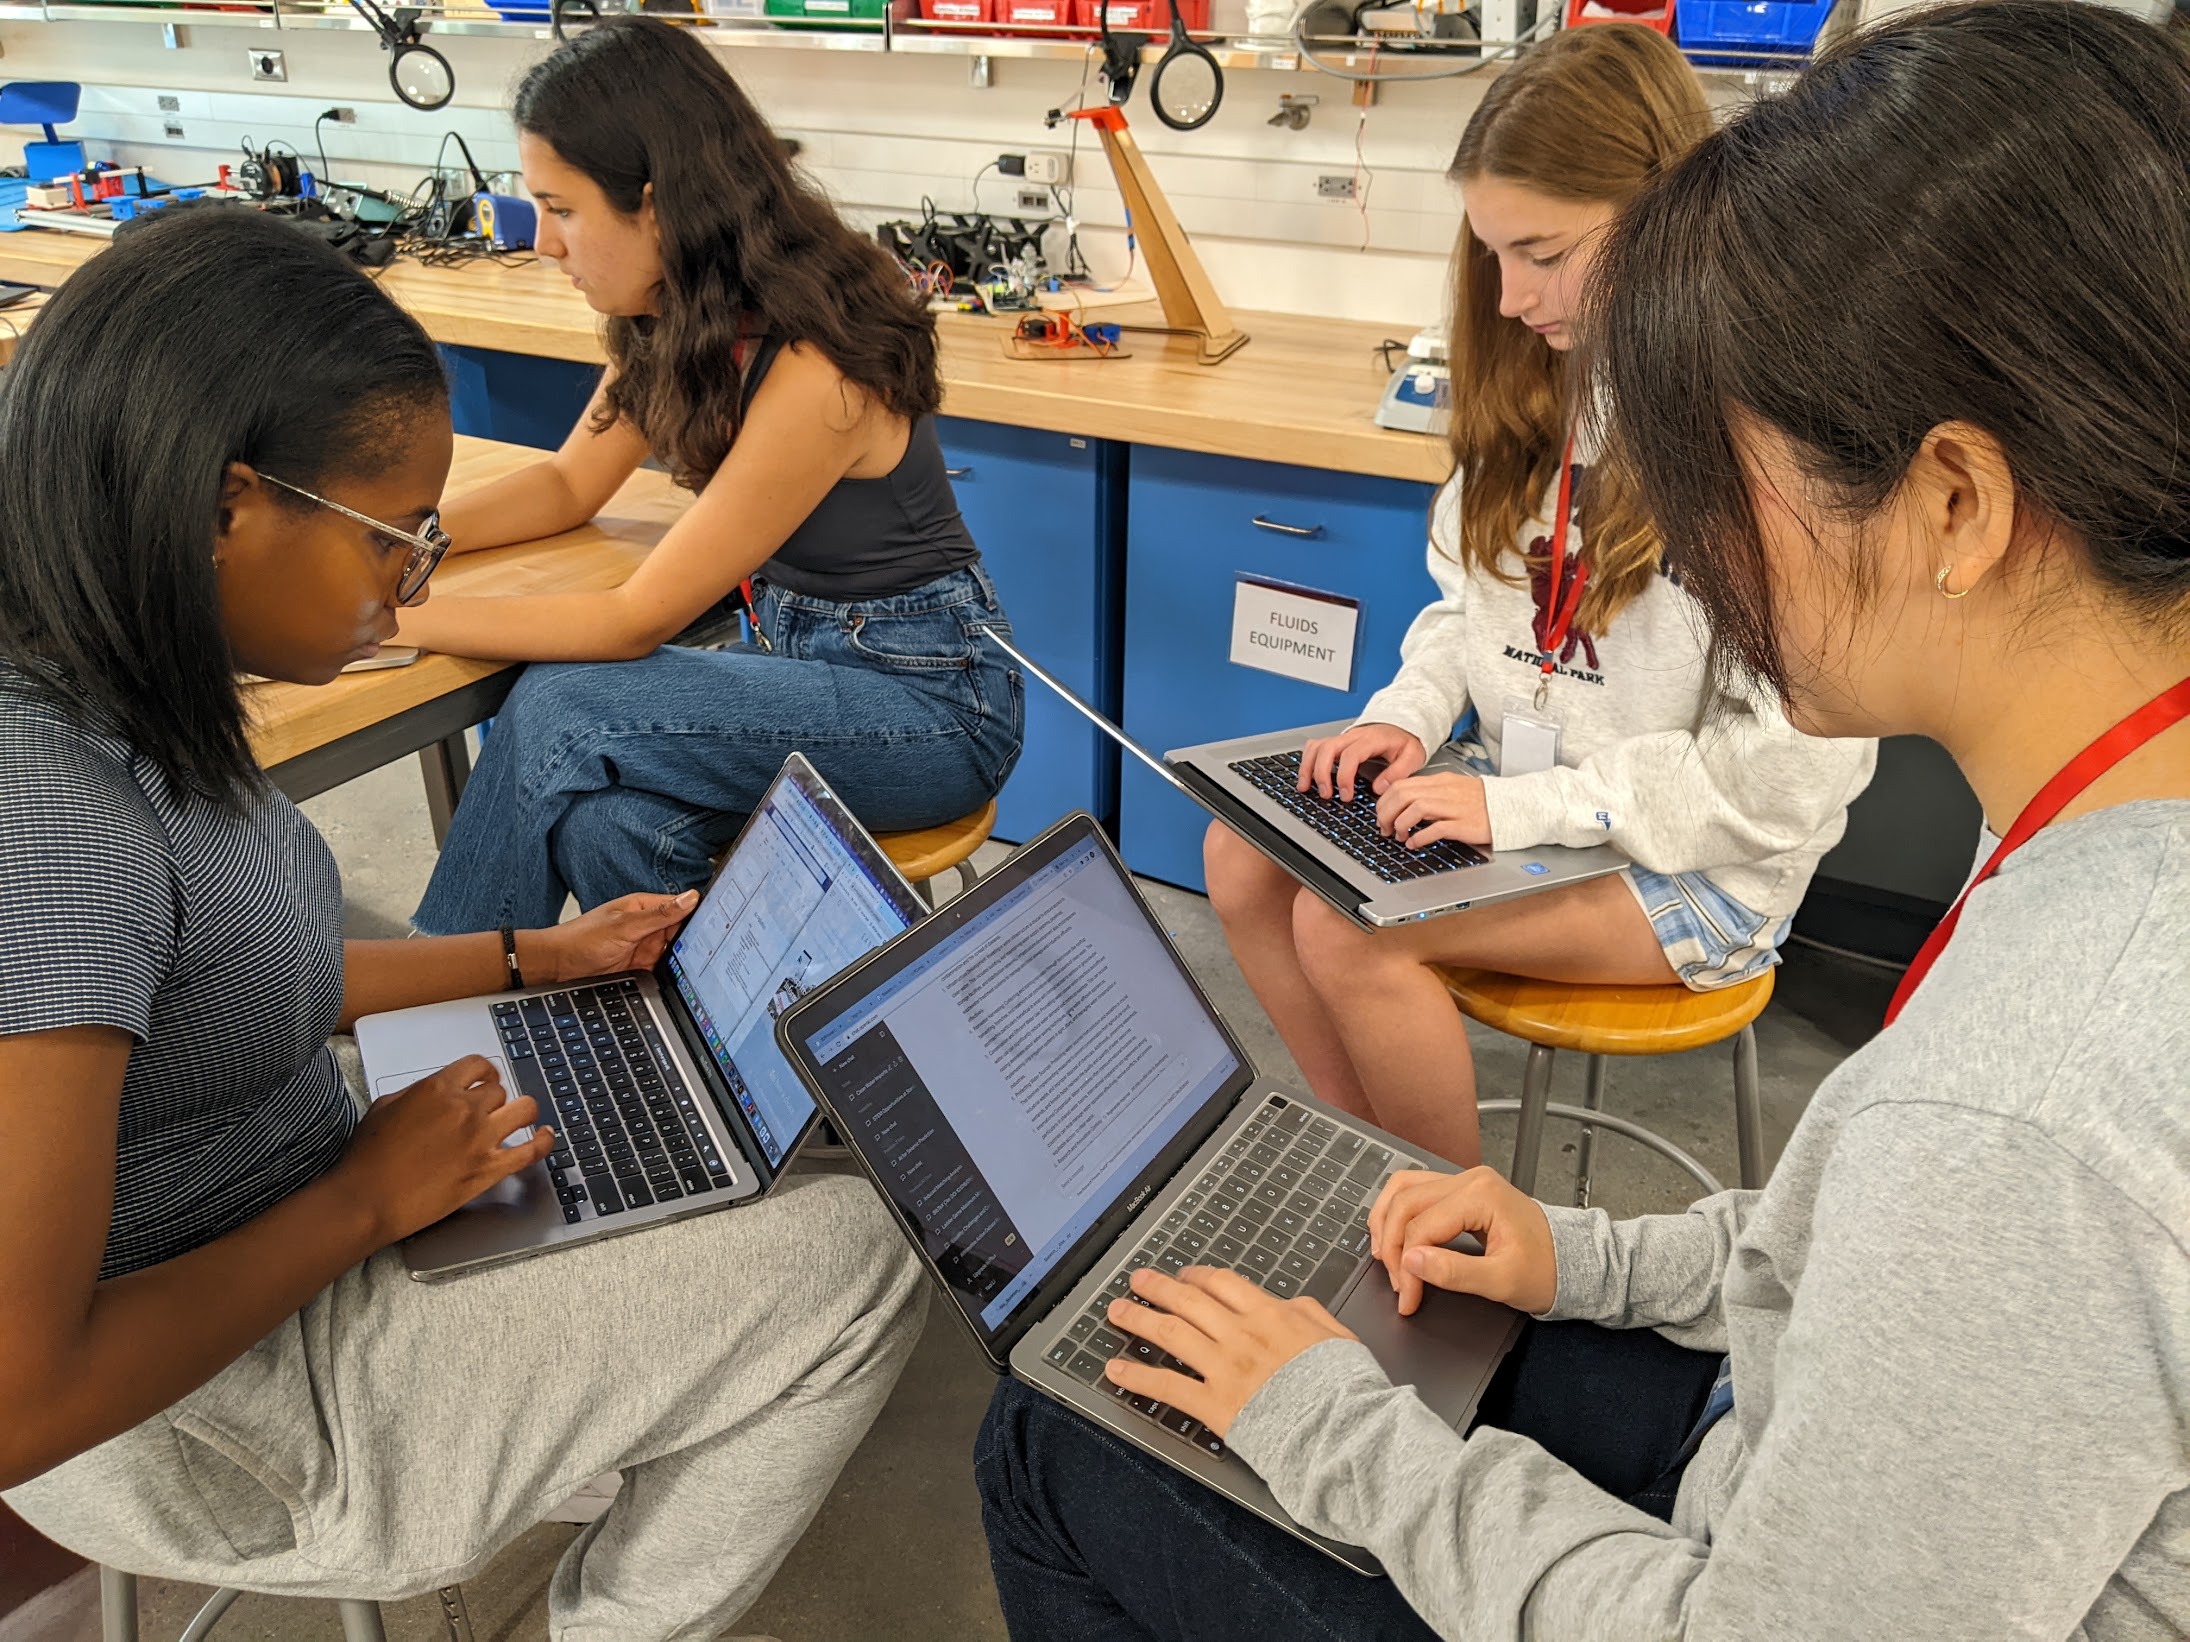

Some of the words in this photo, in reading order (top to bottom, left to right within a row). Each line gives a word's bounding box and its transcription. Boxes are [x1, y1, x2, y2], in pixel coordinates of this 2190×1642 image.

[1270, 612, 1319, 635] FLUIDS
[1249, 631, 1336, 663] EQUIPMENT
[1502, 644, 1568, 676] NATIAL
[1569, 668, 1605, 686] PARK
[1125, 1190, 1147, 1213] MacBook
[1142, 1183, 1152, 1196] Air
[1306, 1241, 1315, 1249] M
[1052, 1349, 1065, 1360] esc
[1114, 1386, 1125, 1396] tab
[1146, 1400, 1160, 1415] caps
[1177, 1418, 1192, 1433] shift
